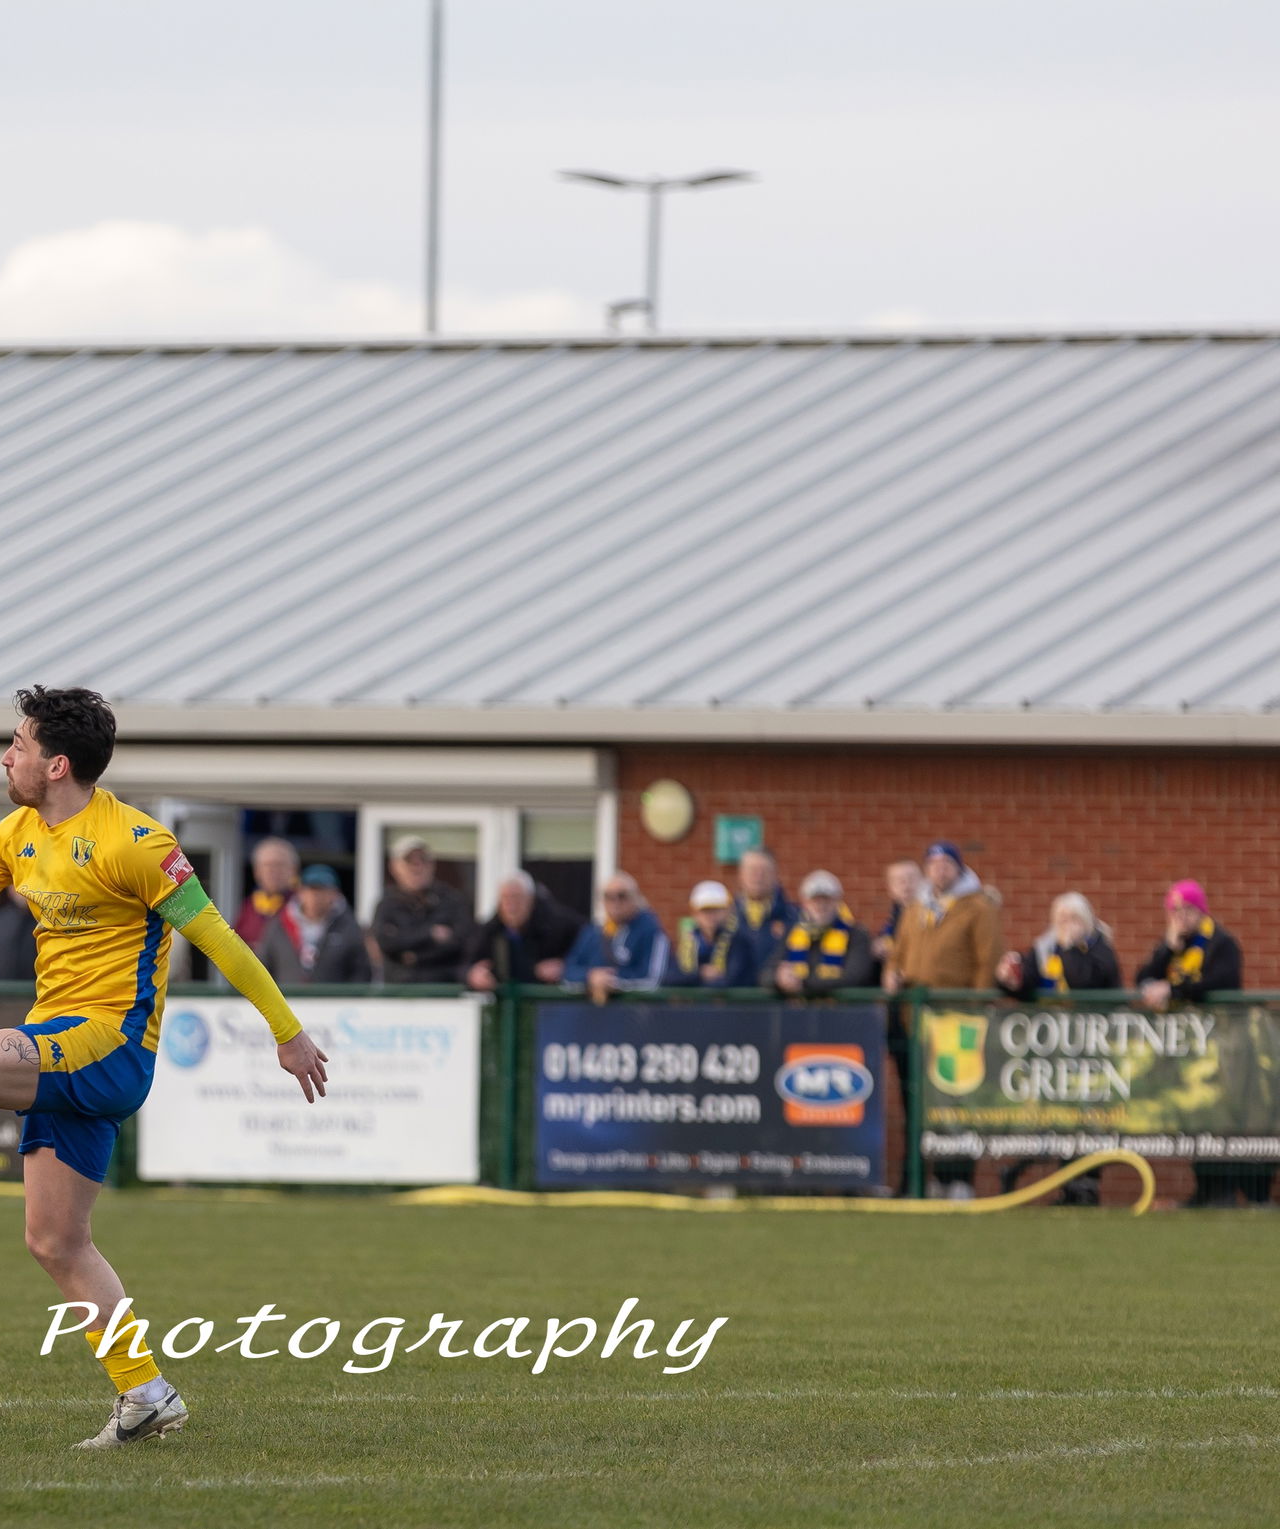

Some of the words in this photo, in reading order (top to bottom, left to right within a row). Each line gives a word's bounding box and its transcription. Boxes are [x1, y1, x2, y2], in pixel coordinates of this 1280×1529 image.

[999, 1012, 1215, 1057] COURTNEY
[543, 1043, 638, 1083] 01403
[640, 1043, 699, 1083] 250
[701, 1043, 761, 1084] 420
[999, 1057, 1132, 1102] GREEN
[543, 1088, 762, 1128] mrprinters.com
[922, 1131, 984, 1160] Proudly
[987, 1132, 1077, 1160] sponsoring
[1077, 1132, 1120, 1154] local
[1121, 1136, 1175, 1155] events
[1176, 1133, 1196, 1154] in
[1197, 1132, 1226, 1155] the
